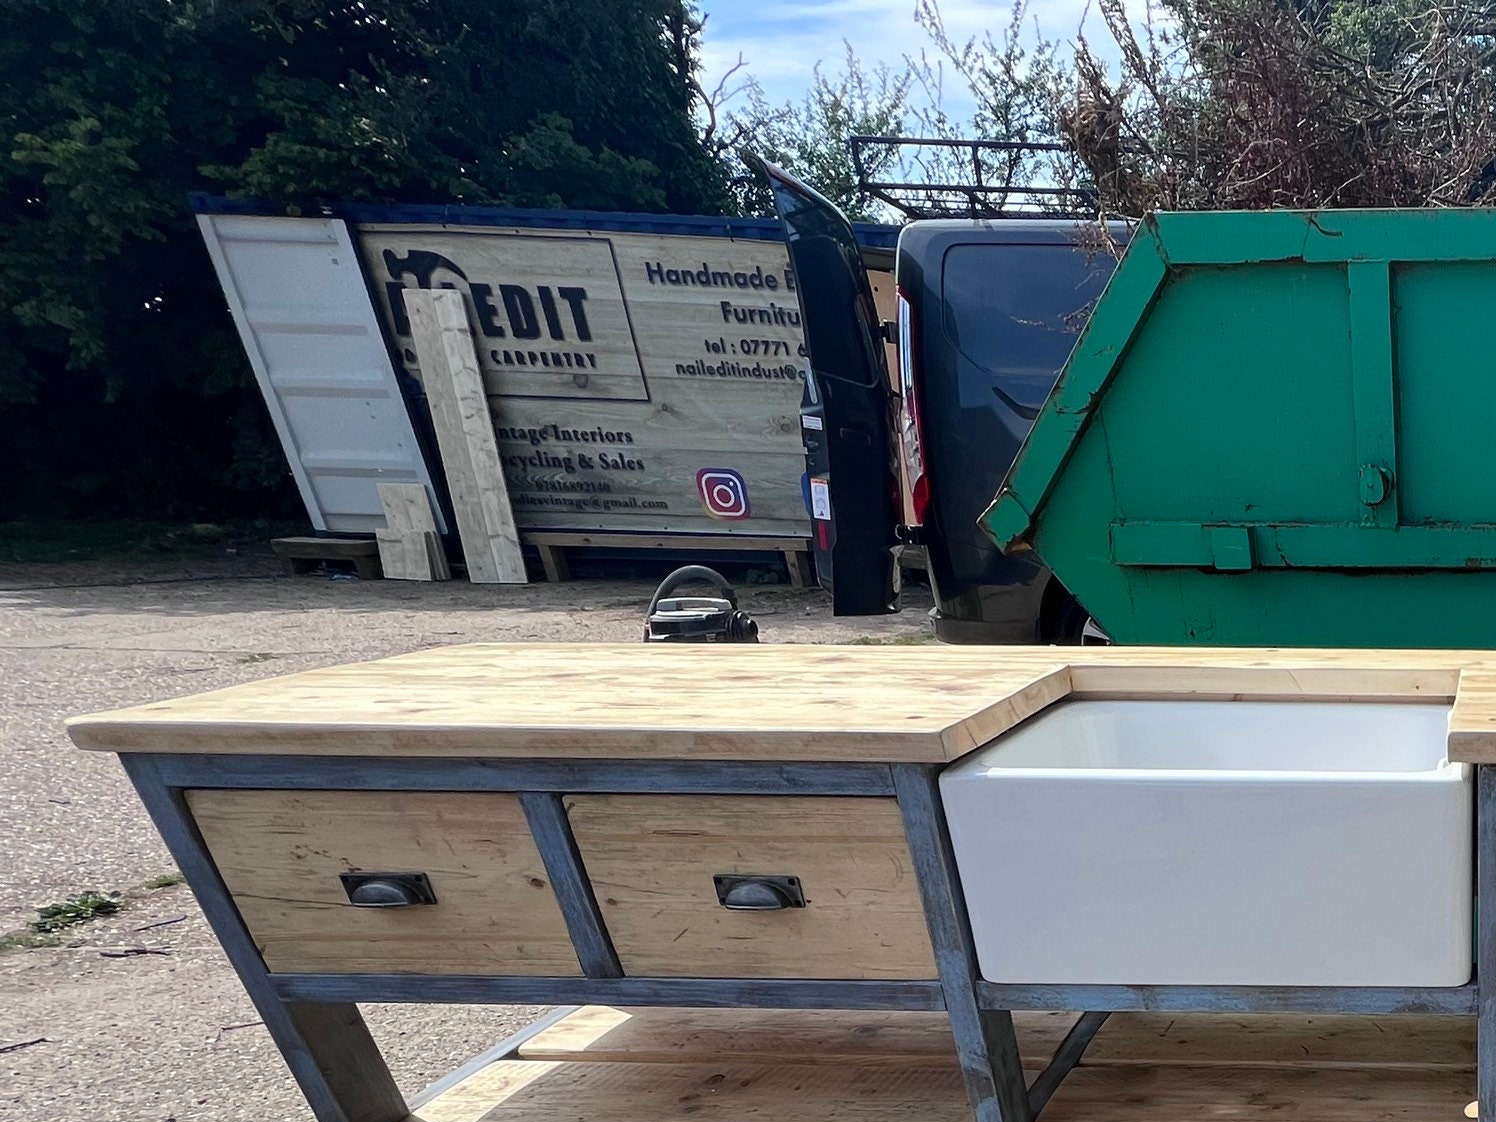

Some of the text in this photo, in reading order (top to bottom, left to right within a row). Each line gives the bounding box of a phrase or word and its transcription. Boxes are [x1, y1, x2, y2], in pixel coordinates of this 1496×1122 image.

[645, 261, 778, 291] Handmade
[721, 301, 801, 327] Furnitu
[704, 337, 726, 354] tel
[740, 339, 791, 356] 07771
[490, 350, 597, 368] CARPENTRY
[498, 424, 634, 446] ntage Interiors
[577, 453, 594, 471] &
[599, 452, 646, 472] Sales
